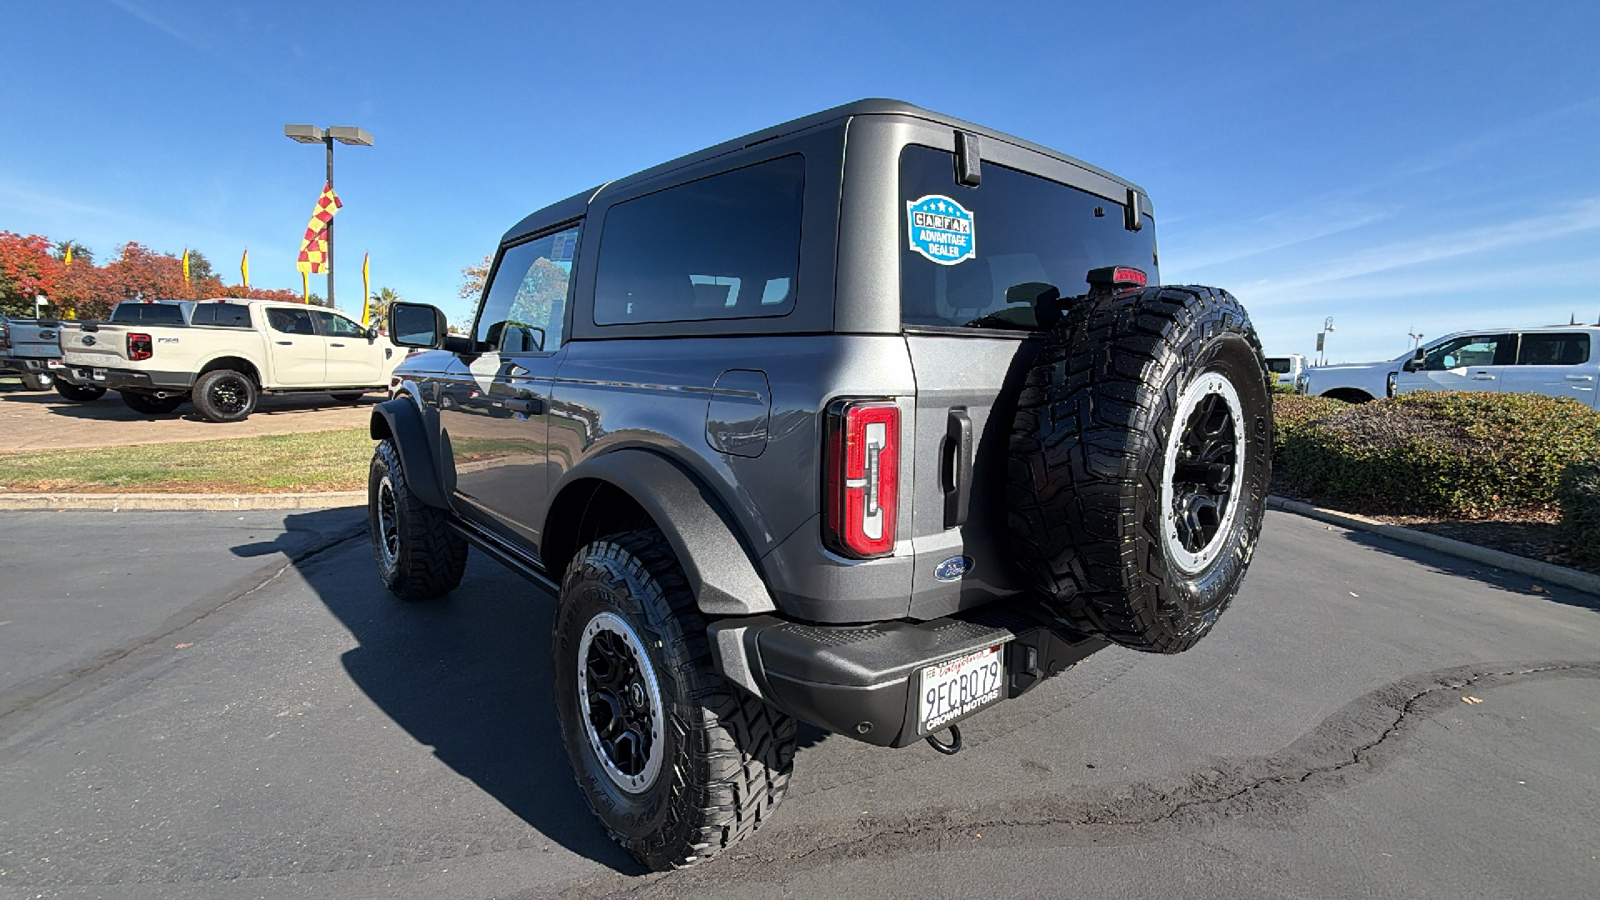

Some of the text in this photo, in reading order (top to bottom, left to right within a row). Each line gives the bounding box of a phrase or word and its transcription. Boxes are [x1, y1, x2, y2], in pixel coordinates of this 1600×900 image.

[914, 212, 969, 233] CARFAX
[920, 229, 967, 247] ADVANTAGE
[928, 243, 960, 257] DEALER
[926, 661, 998, 719] 9FCB079
[926, 689, 999, 730] CROWN MOTORS
